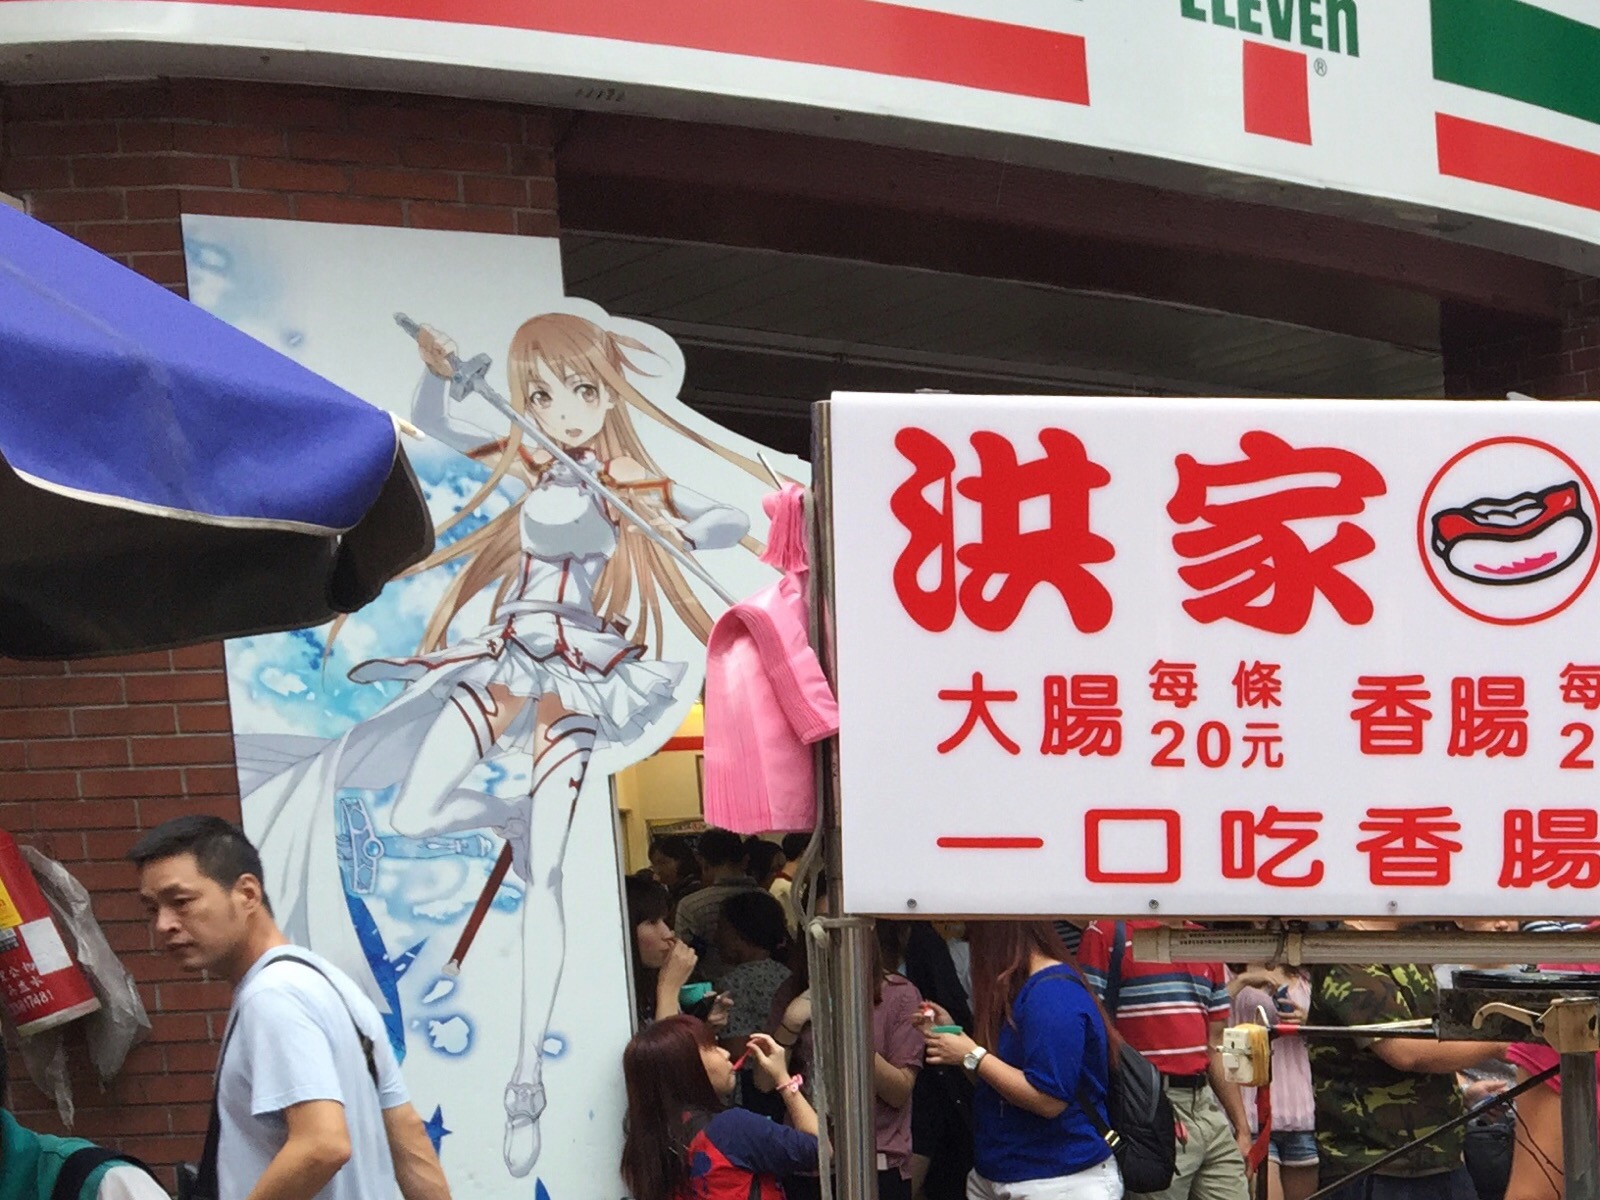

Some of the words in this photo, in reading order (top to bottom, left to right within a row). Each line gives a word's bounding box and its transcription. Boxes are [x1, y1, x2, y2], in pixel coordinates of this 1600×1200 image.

[890, 427, 1387, 636] 洪家
[937, 672, 1122, 756] 大腸
[1149, 659, 1282, 709] 每條
[1350, 674, 1528, 758] 香腸
[1151, 719, 1284, 770] 20元
